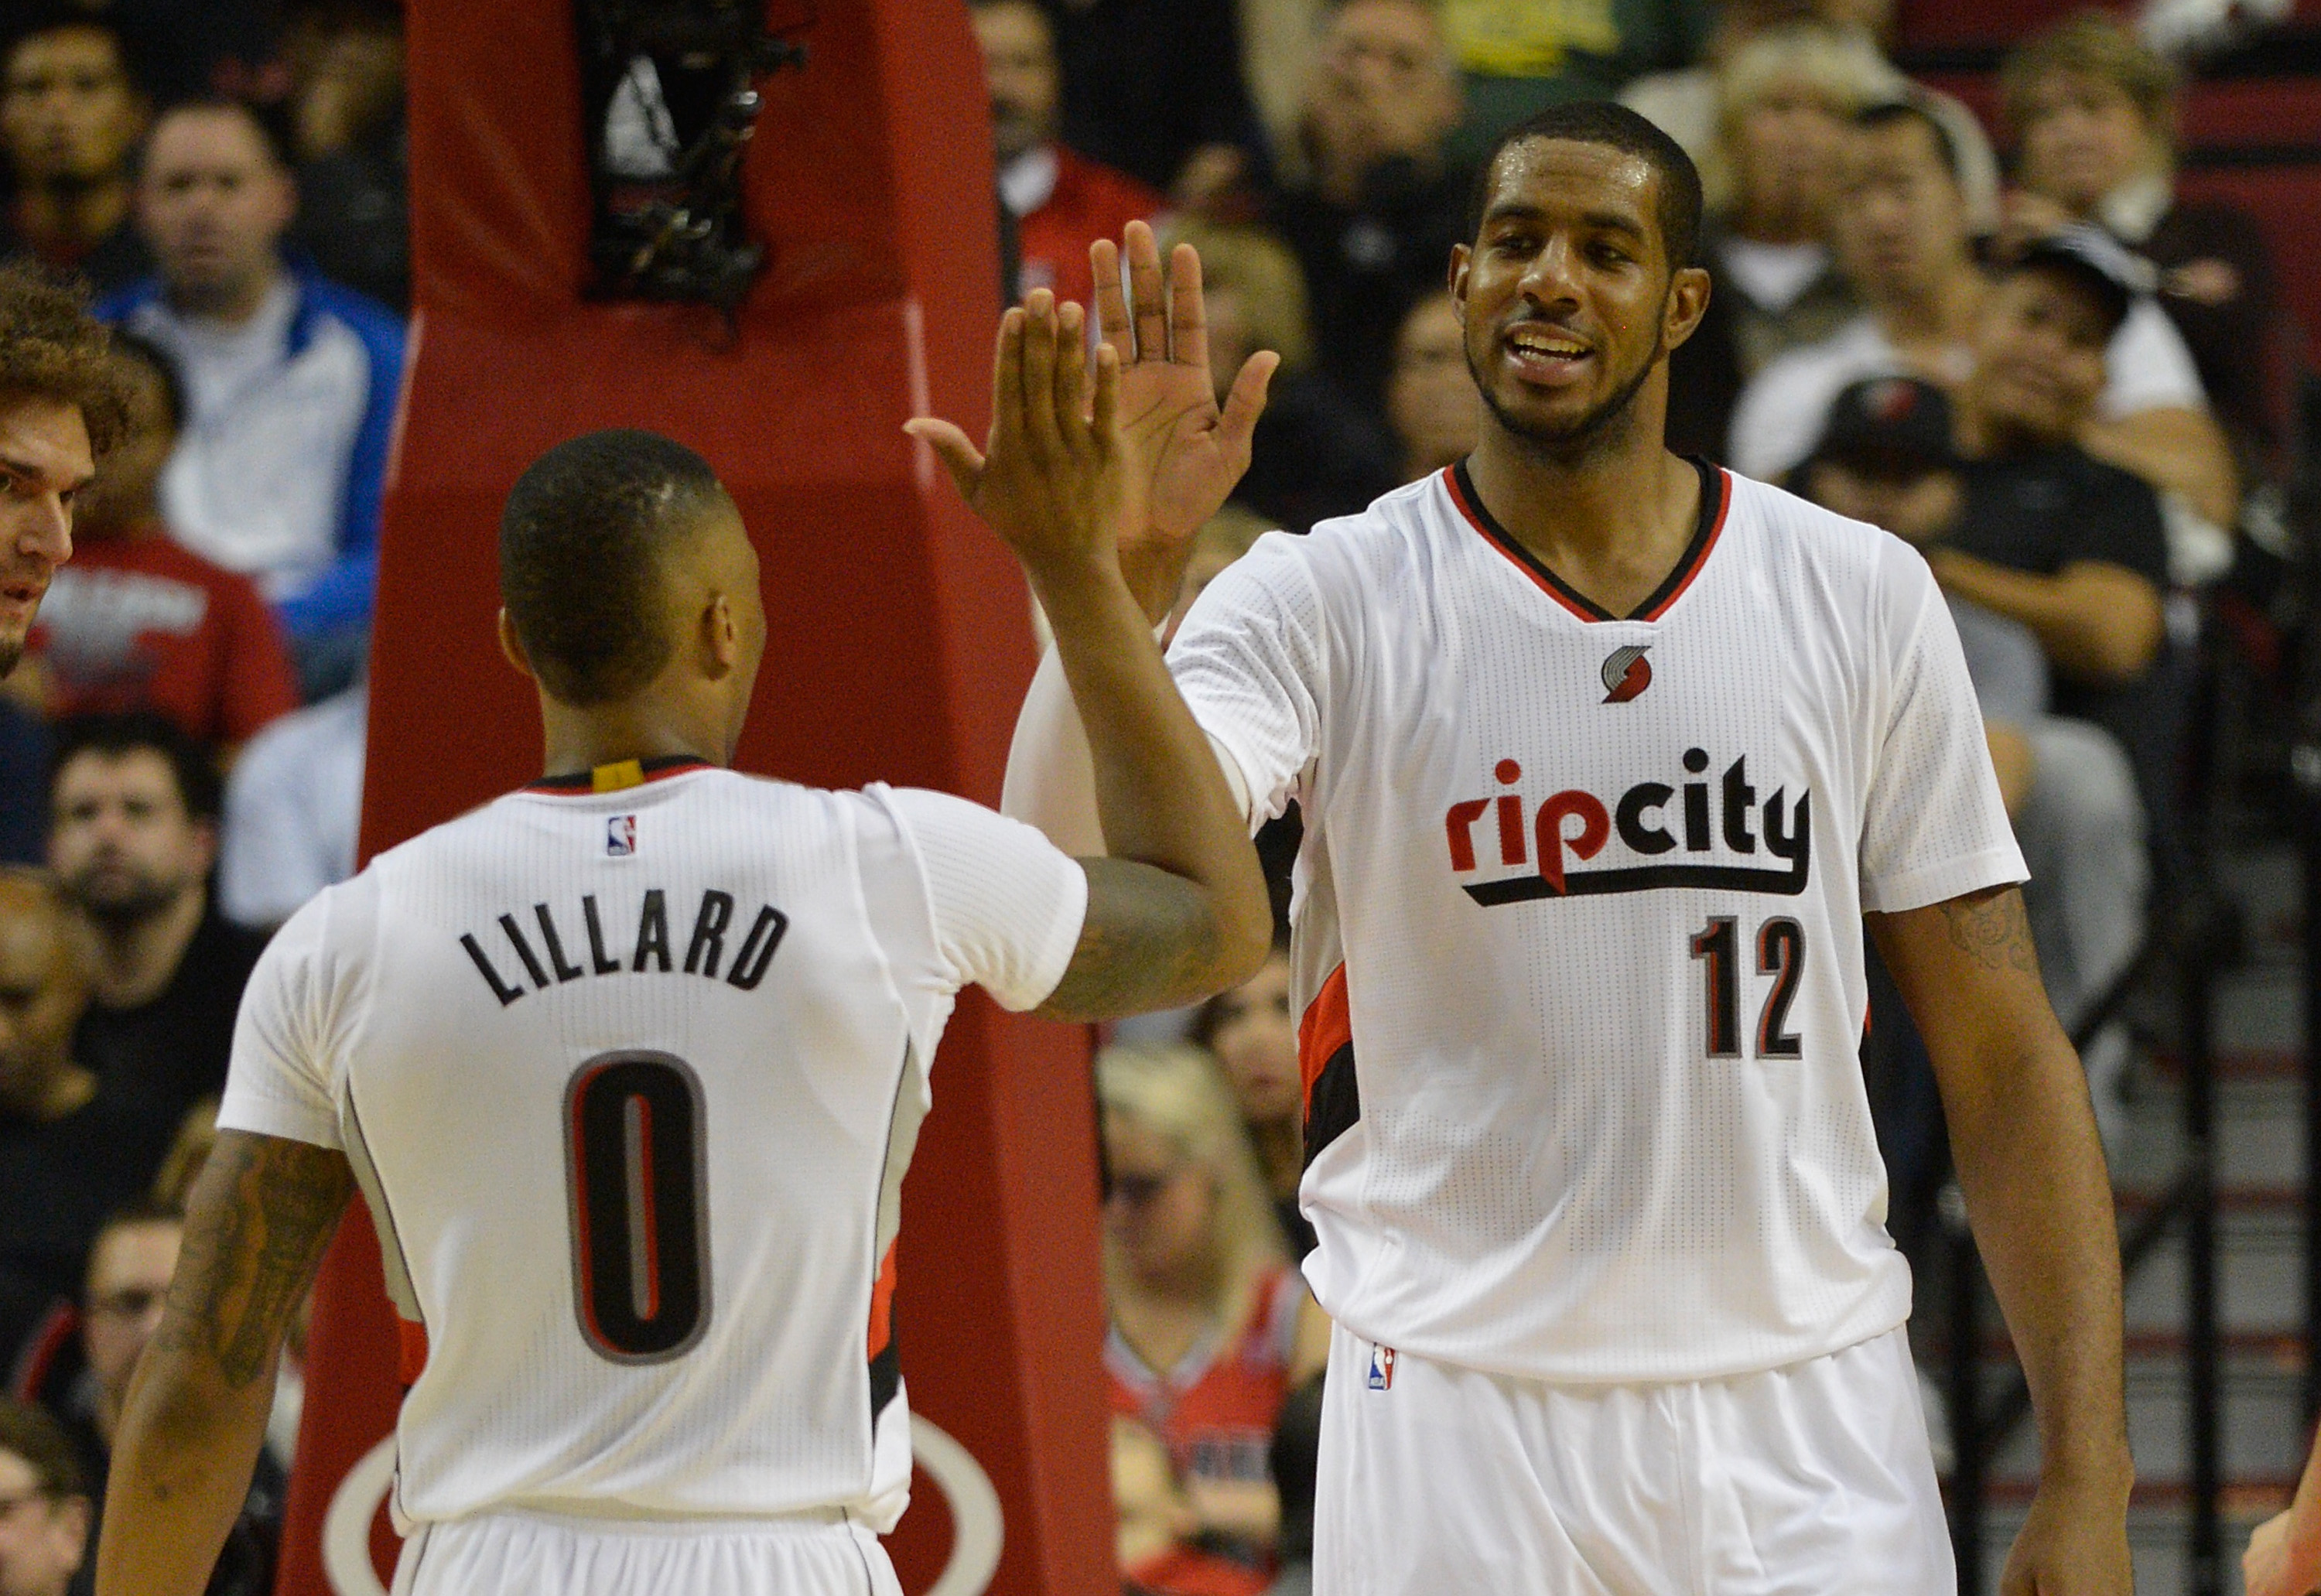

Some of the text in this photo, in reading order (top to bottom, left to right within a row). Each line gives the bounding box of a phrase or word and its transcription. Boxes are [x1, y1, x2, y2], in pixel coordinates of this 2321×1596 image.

[460, 889, 790, 1007] LILLARD
[1690, 915, 1807, 1060] 12
[562, 1049, 714, 1367] 0
